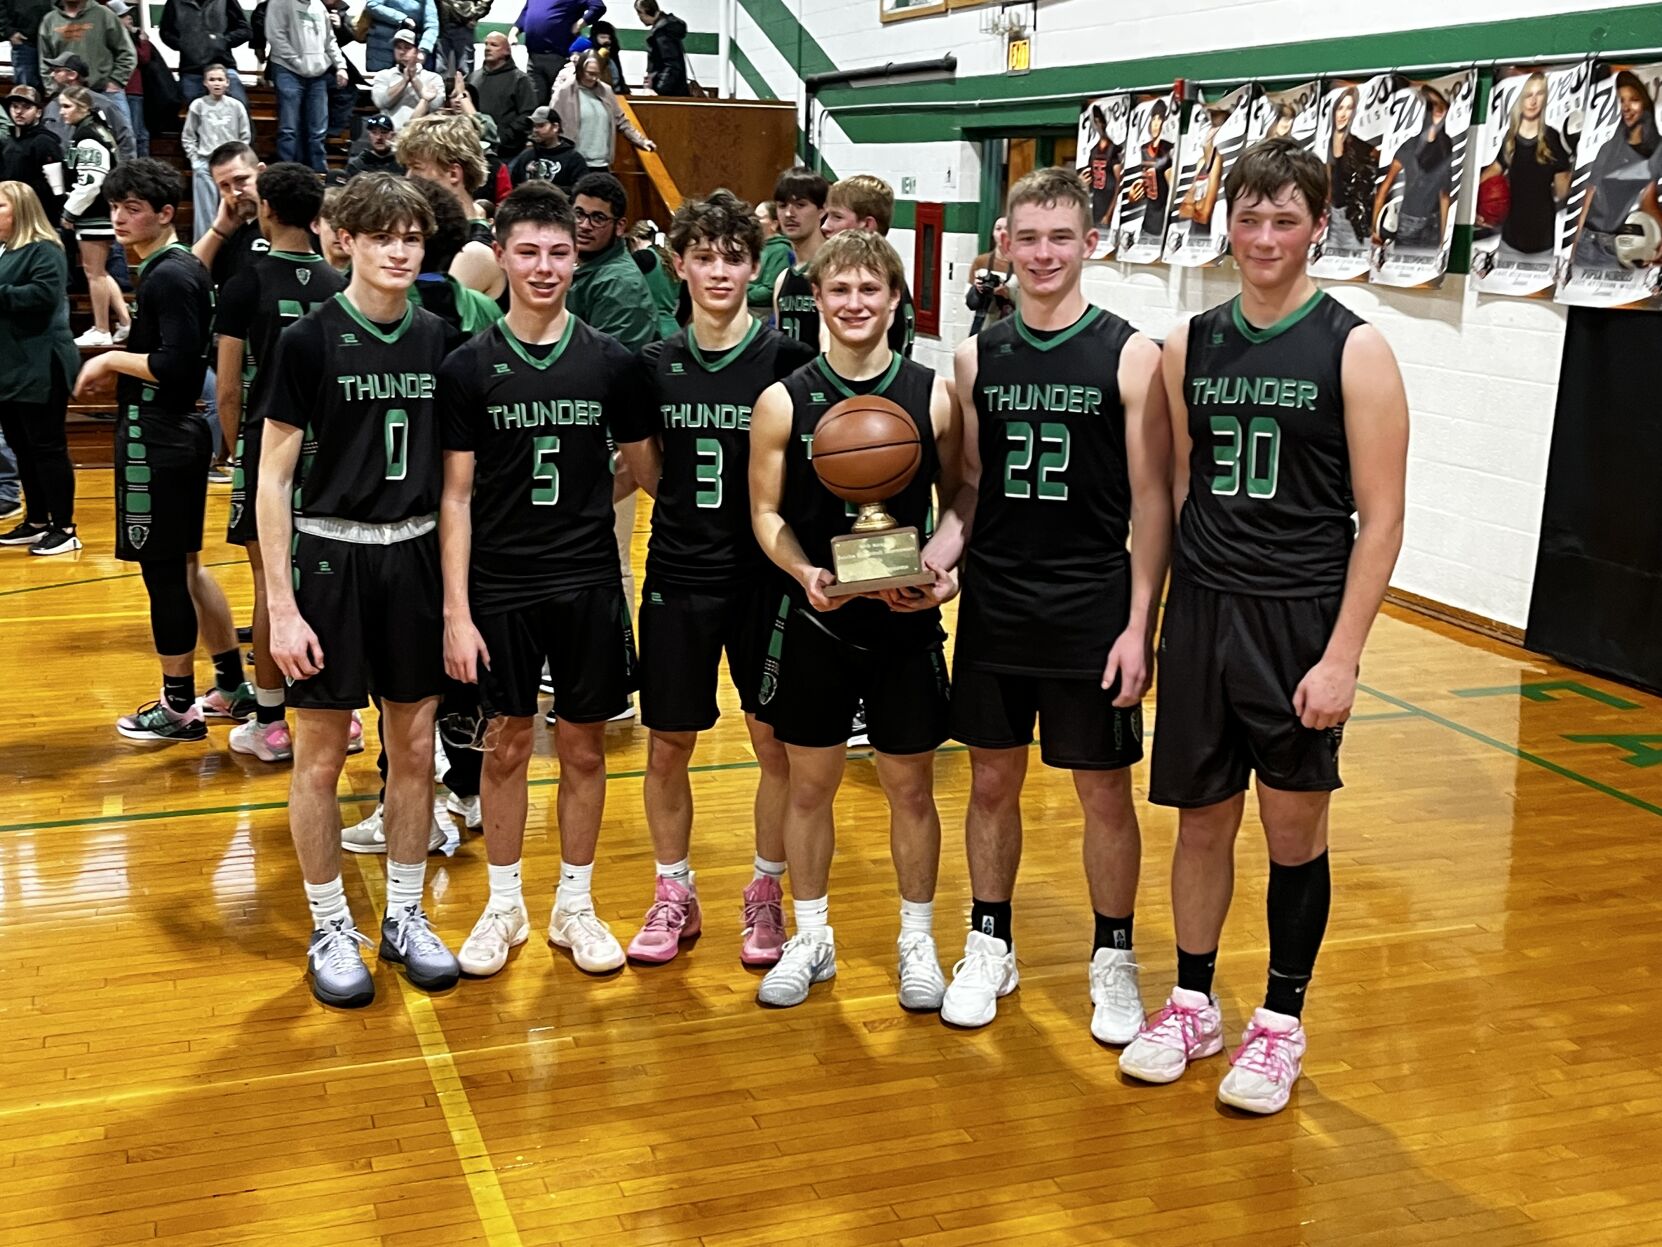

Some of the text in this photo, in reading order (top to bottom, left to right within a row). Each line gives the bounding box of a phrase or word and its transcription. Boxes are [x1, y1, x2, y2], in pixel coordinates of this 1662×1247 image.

[486, 400, 602, 430] THUNDER
[660, 403, 752, 431] THUNDE
[983, 384, 1102, 415] THUNDER
[1192, 377, 1319, 410] THUNDER
[384, 409, 409, 480] 0
[531, 436, 560, 506] 5
[696, 438, 723, 509] 3
[1004, 421, 1071, 501] 22
[1209, 416, 1281, 499] 30
